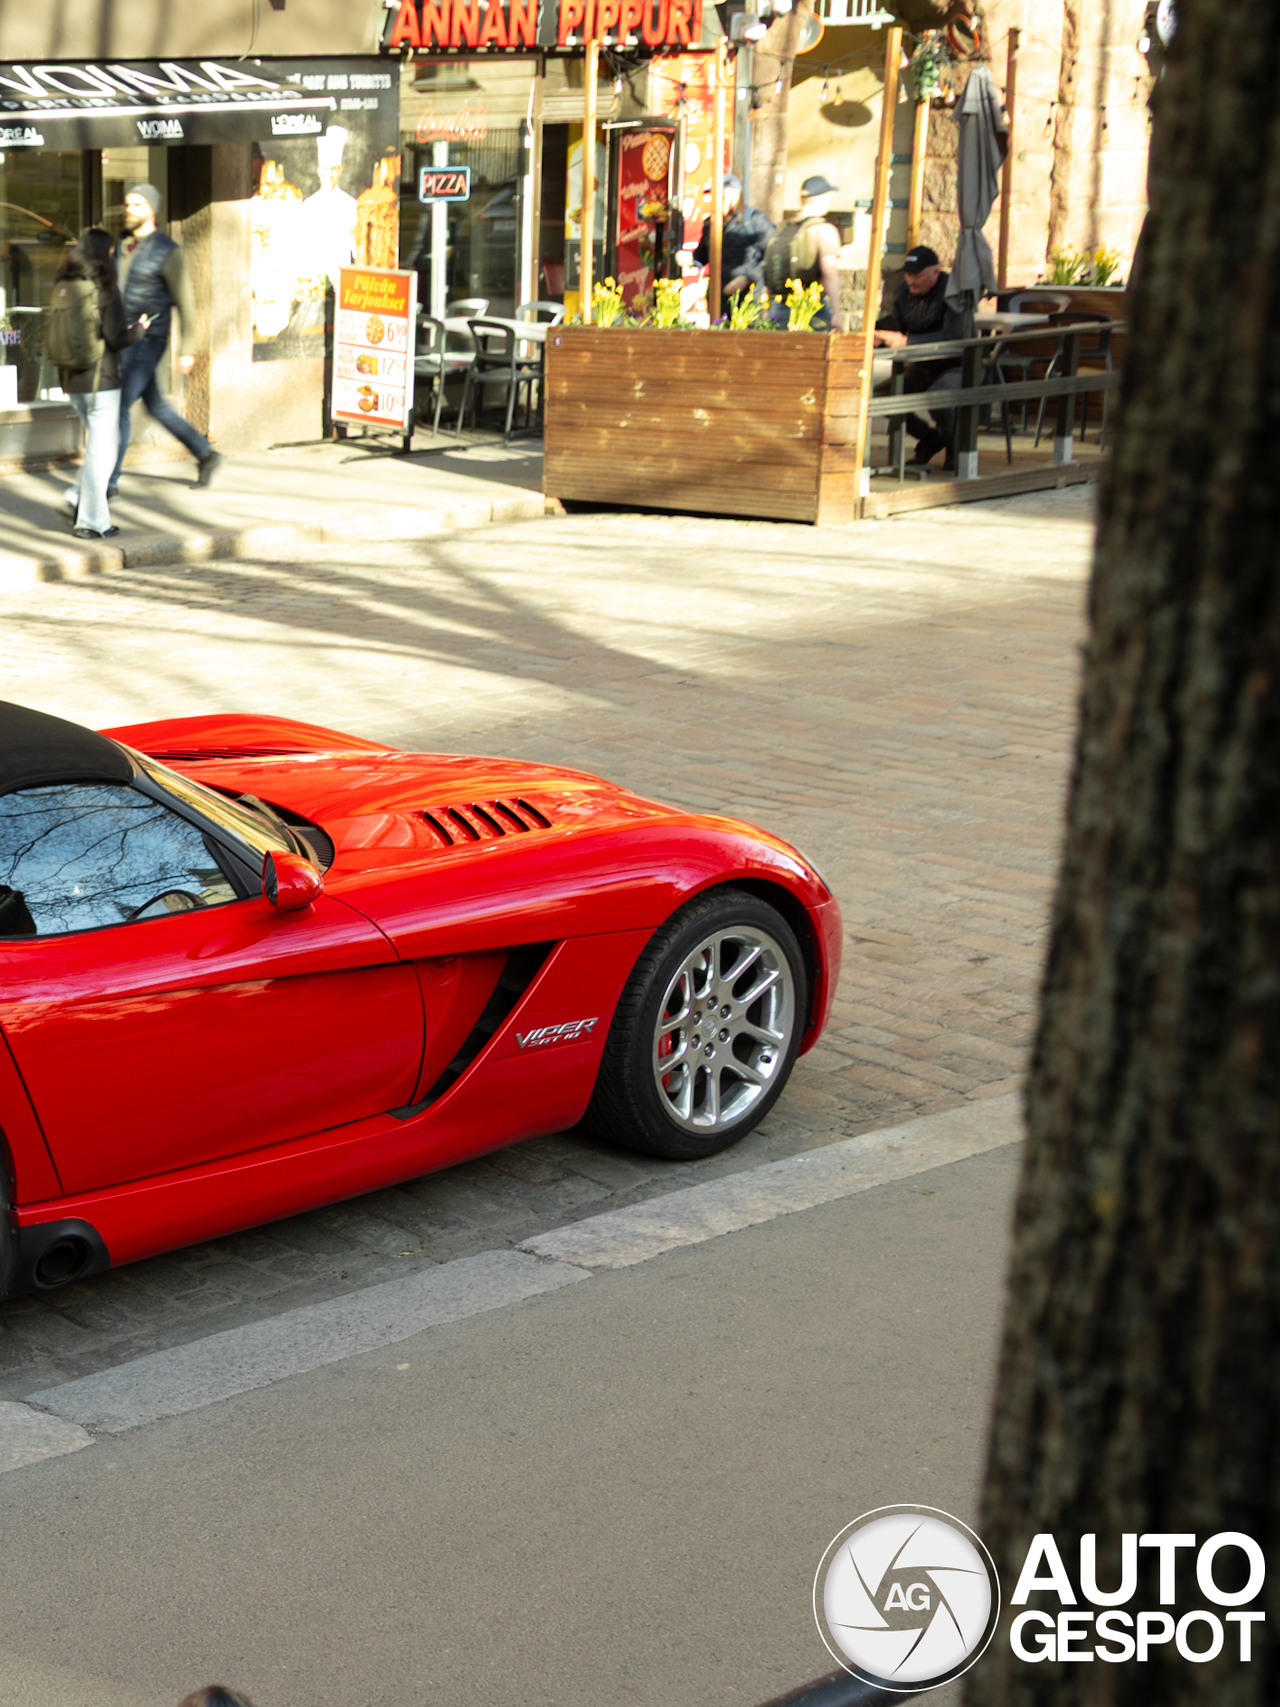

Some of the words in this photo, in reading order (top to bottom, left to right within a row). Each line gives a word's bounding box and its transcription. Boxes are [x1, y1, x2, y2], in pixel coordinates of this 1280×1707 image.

[390, 0, 538, 47] ANNAN
[557, 0, 704, 47] PIPPURI
[137, 119, 184, 136] WOIMA
[423, 173, 468, 196] PIZZA
[353, 274, 397, 294] Päivän
[343, 288, 406, 311] Tarjoukset
[516, 1017, 599, 1049] VIPER
[528, 1034, 563, 1048] SRT
